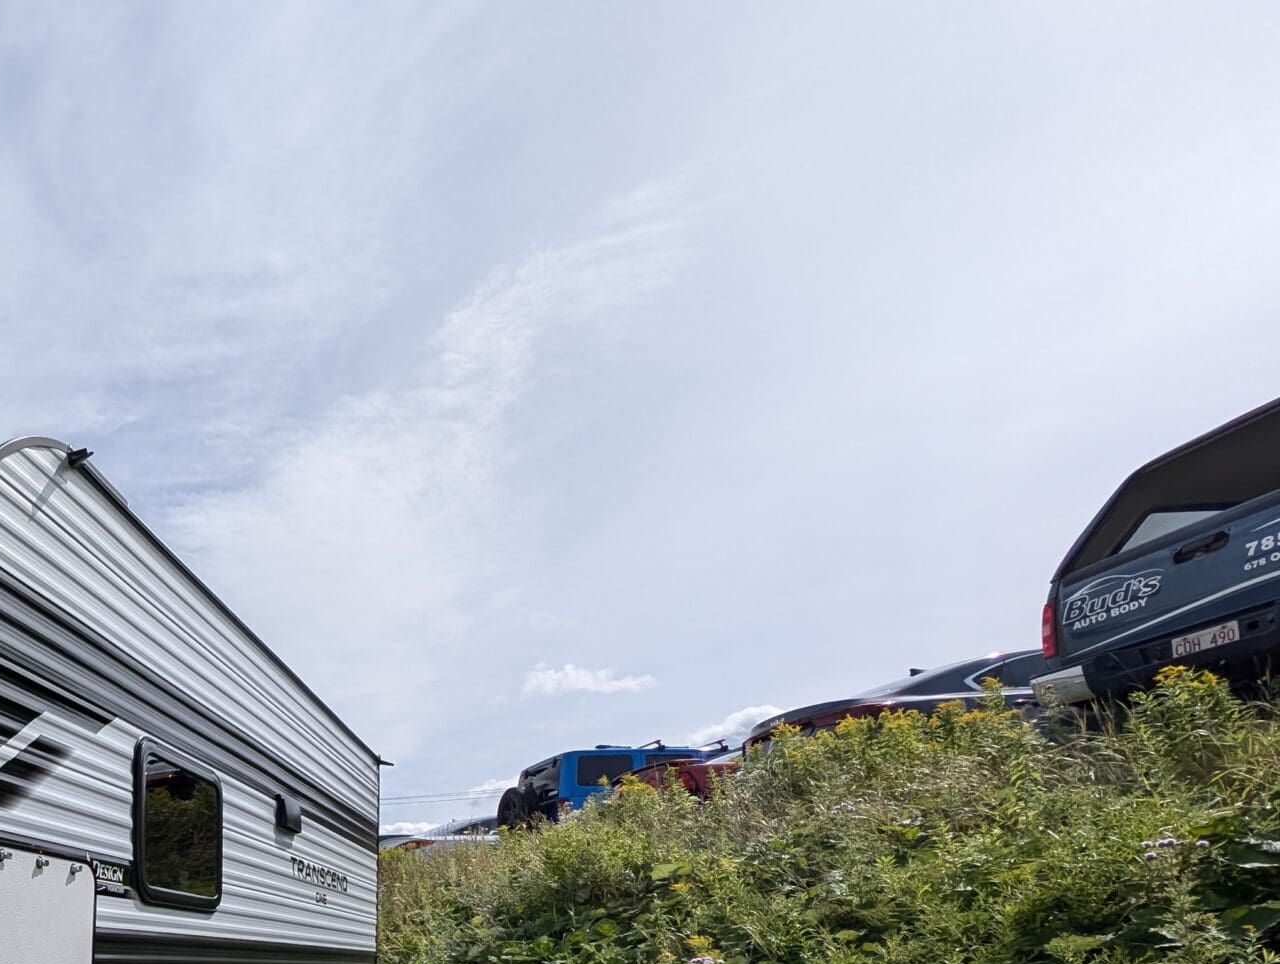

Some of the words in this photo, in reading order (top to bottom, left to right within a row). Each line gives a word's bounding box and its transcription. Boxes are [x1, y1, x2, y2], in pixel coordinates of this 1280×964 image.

[1063, 576, 1162, 625] Bud's
[1073, 612, 1107, 630] AUTO
[1111, 597, 1148, 617] BODY
[1210, 628, 1235, 646] 490
[290, 856, 348, 892] TRANSCEND
